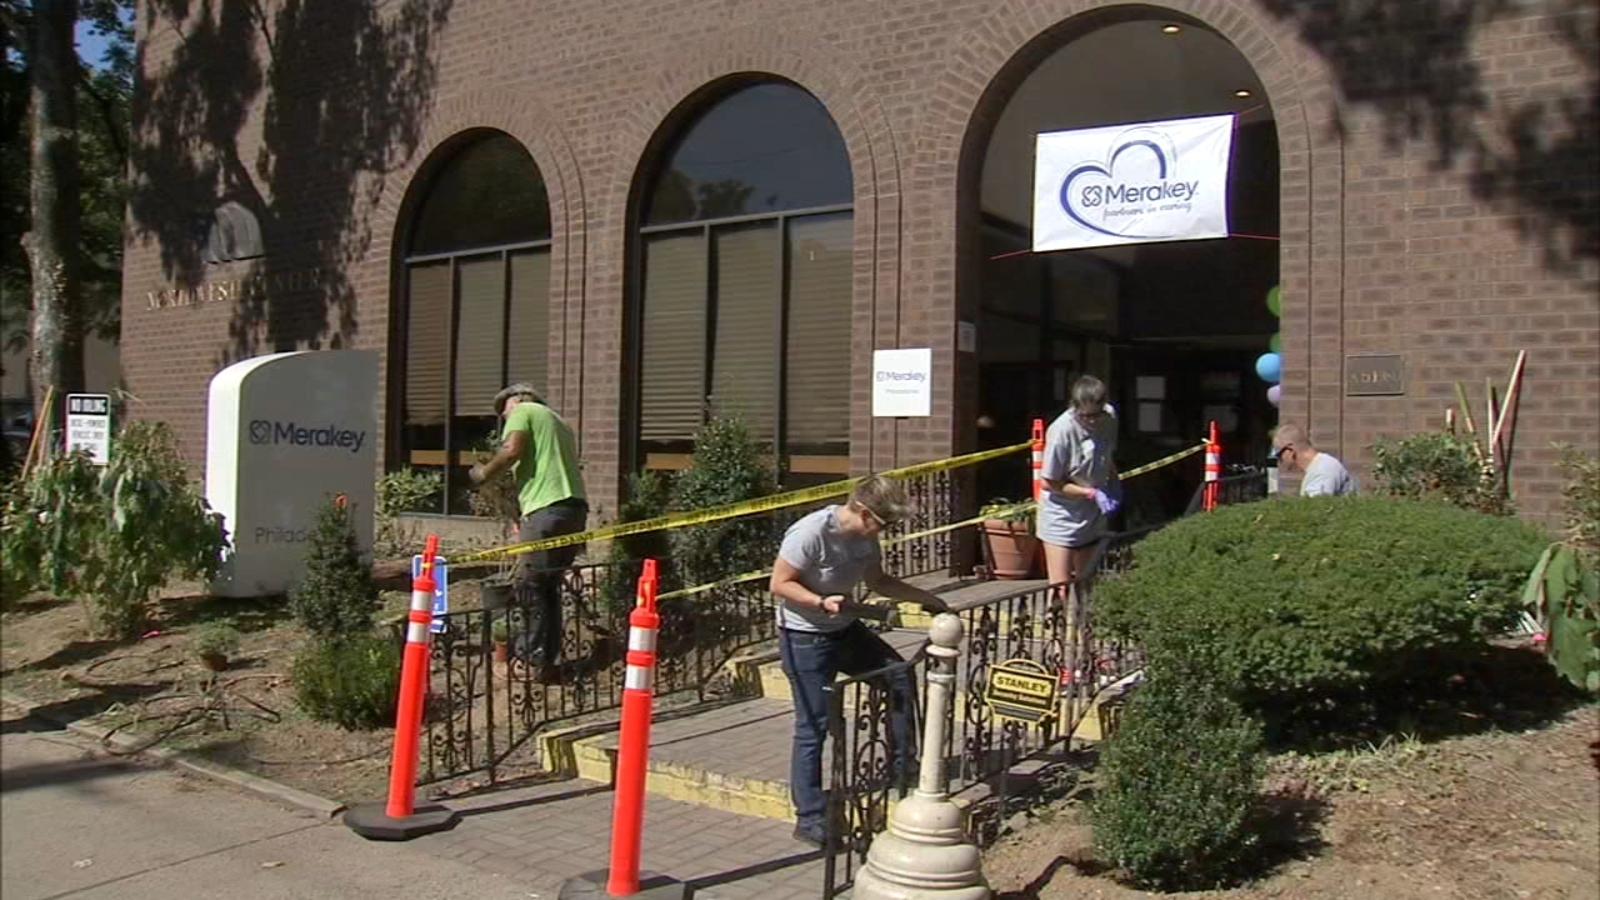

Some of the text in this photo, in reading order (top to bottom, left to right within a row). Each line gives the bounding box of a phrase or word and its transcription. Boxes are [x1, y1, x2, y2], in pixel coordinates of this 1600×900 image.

[1105, 180, 1199, 205] Merakey
[1103, 206, 1144, 221] partners
[886, 370, 927, 383] Merakey
[274, 421, 366, 452] Merakey
[639, 516, 668, 530] PAINT
[255, 526, 318, 544] Philade
[560, 532, 594, 547] PAINT
[996, 676, 1047, 694] STANLEY
